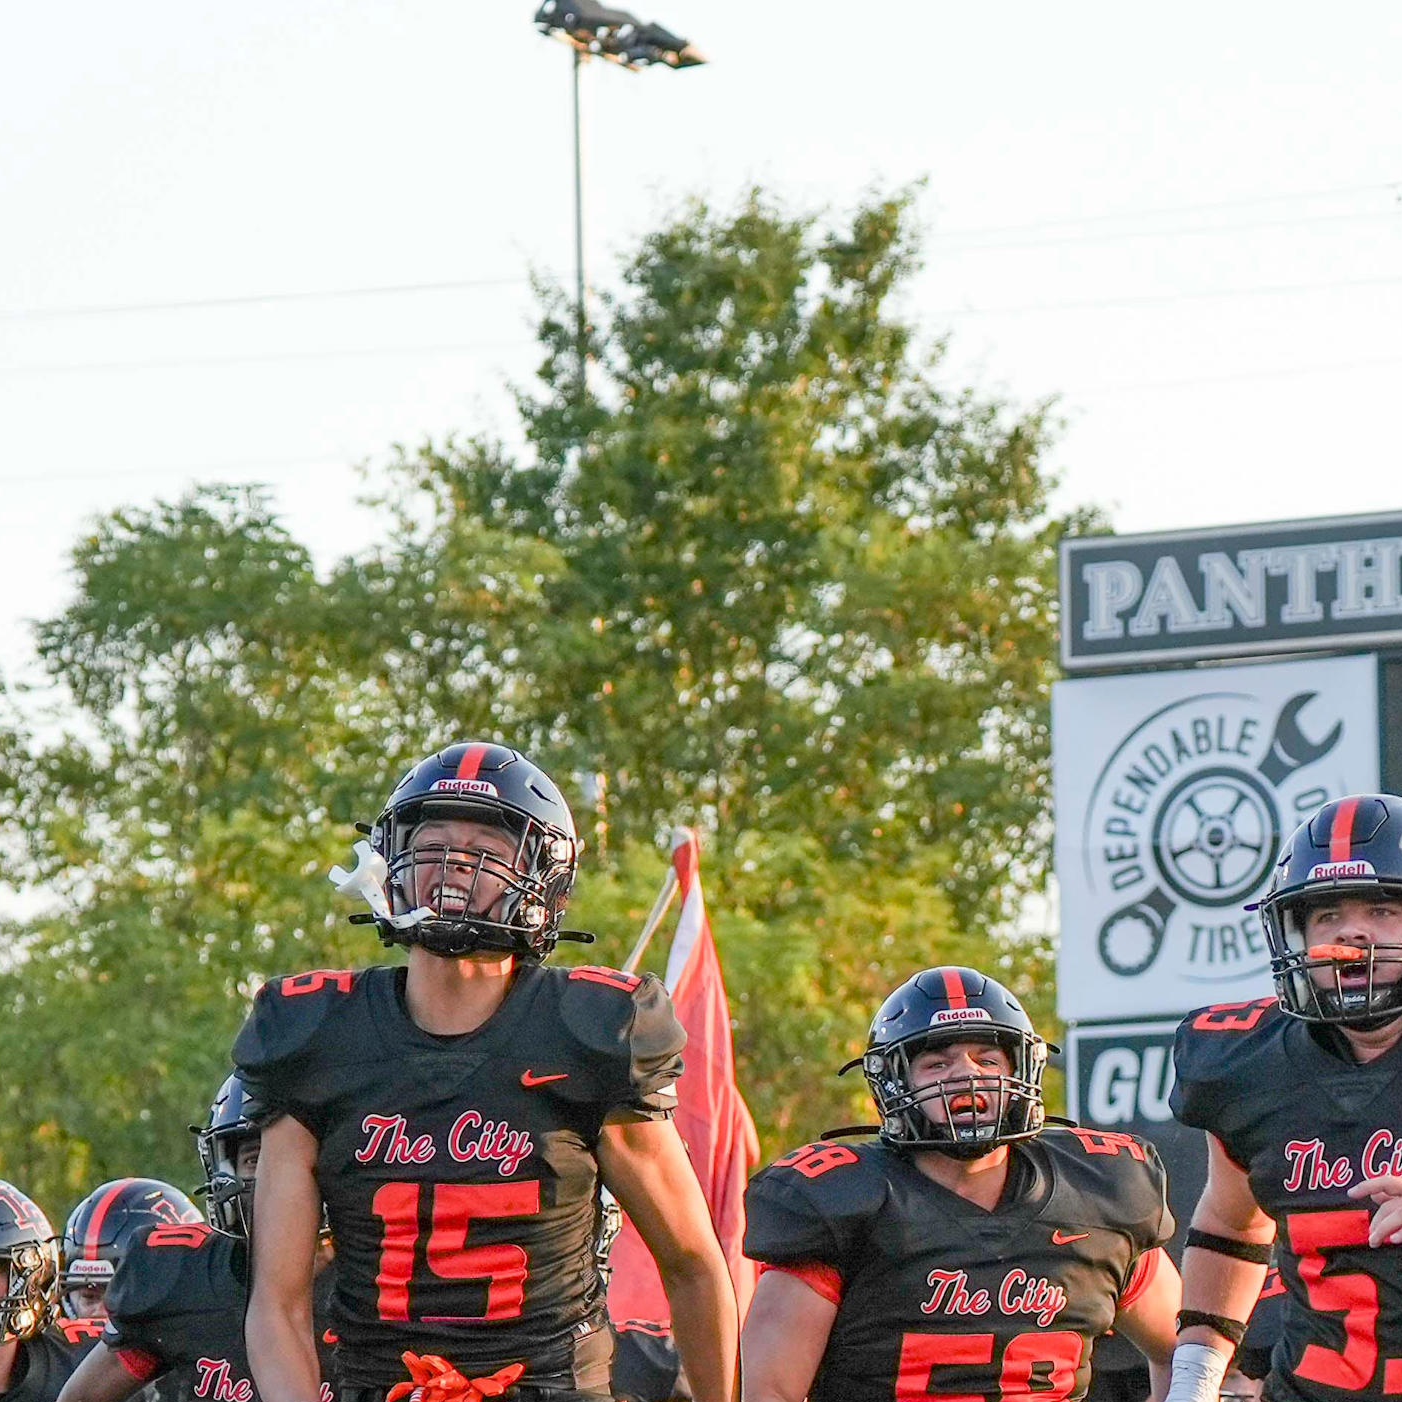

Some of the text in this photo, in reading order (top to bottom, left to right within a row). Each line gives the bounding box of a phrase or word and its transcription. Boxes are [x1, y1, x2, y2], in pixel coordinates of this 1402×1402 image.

[437, 780, 490, 794] Riddell
[1103, 714, 1260, 892] DEPENDABLE
[1315, 863, 1365, 878] Riddell
[1187, 915, 1266, 964] TIRE
[938, 1009, 983, 1022] Riddell
[1089, 1045, 1176, 1125] GU
[355, 1109, 535, 1177] The City
[1284, 1138, 1353, 1192] The
[372, 1180, 540, 1322] 15
[921, 1267, 1067, 1328] The City
